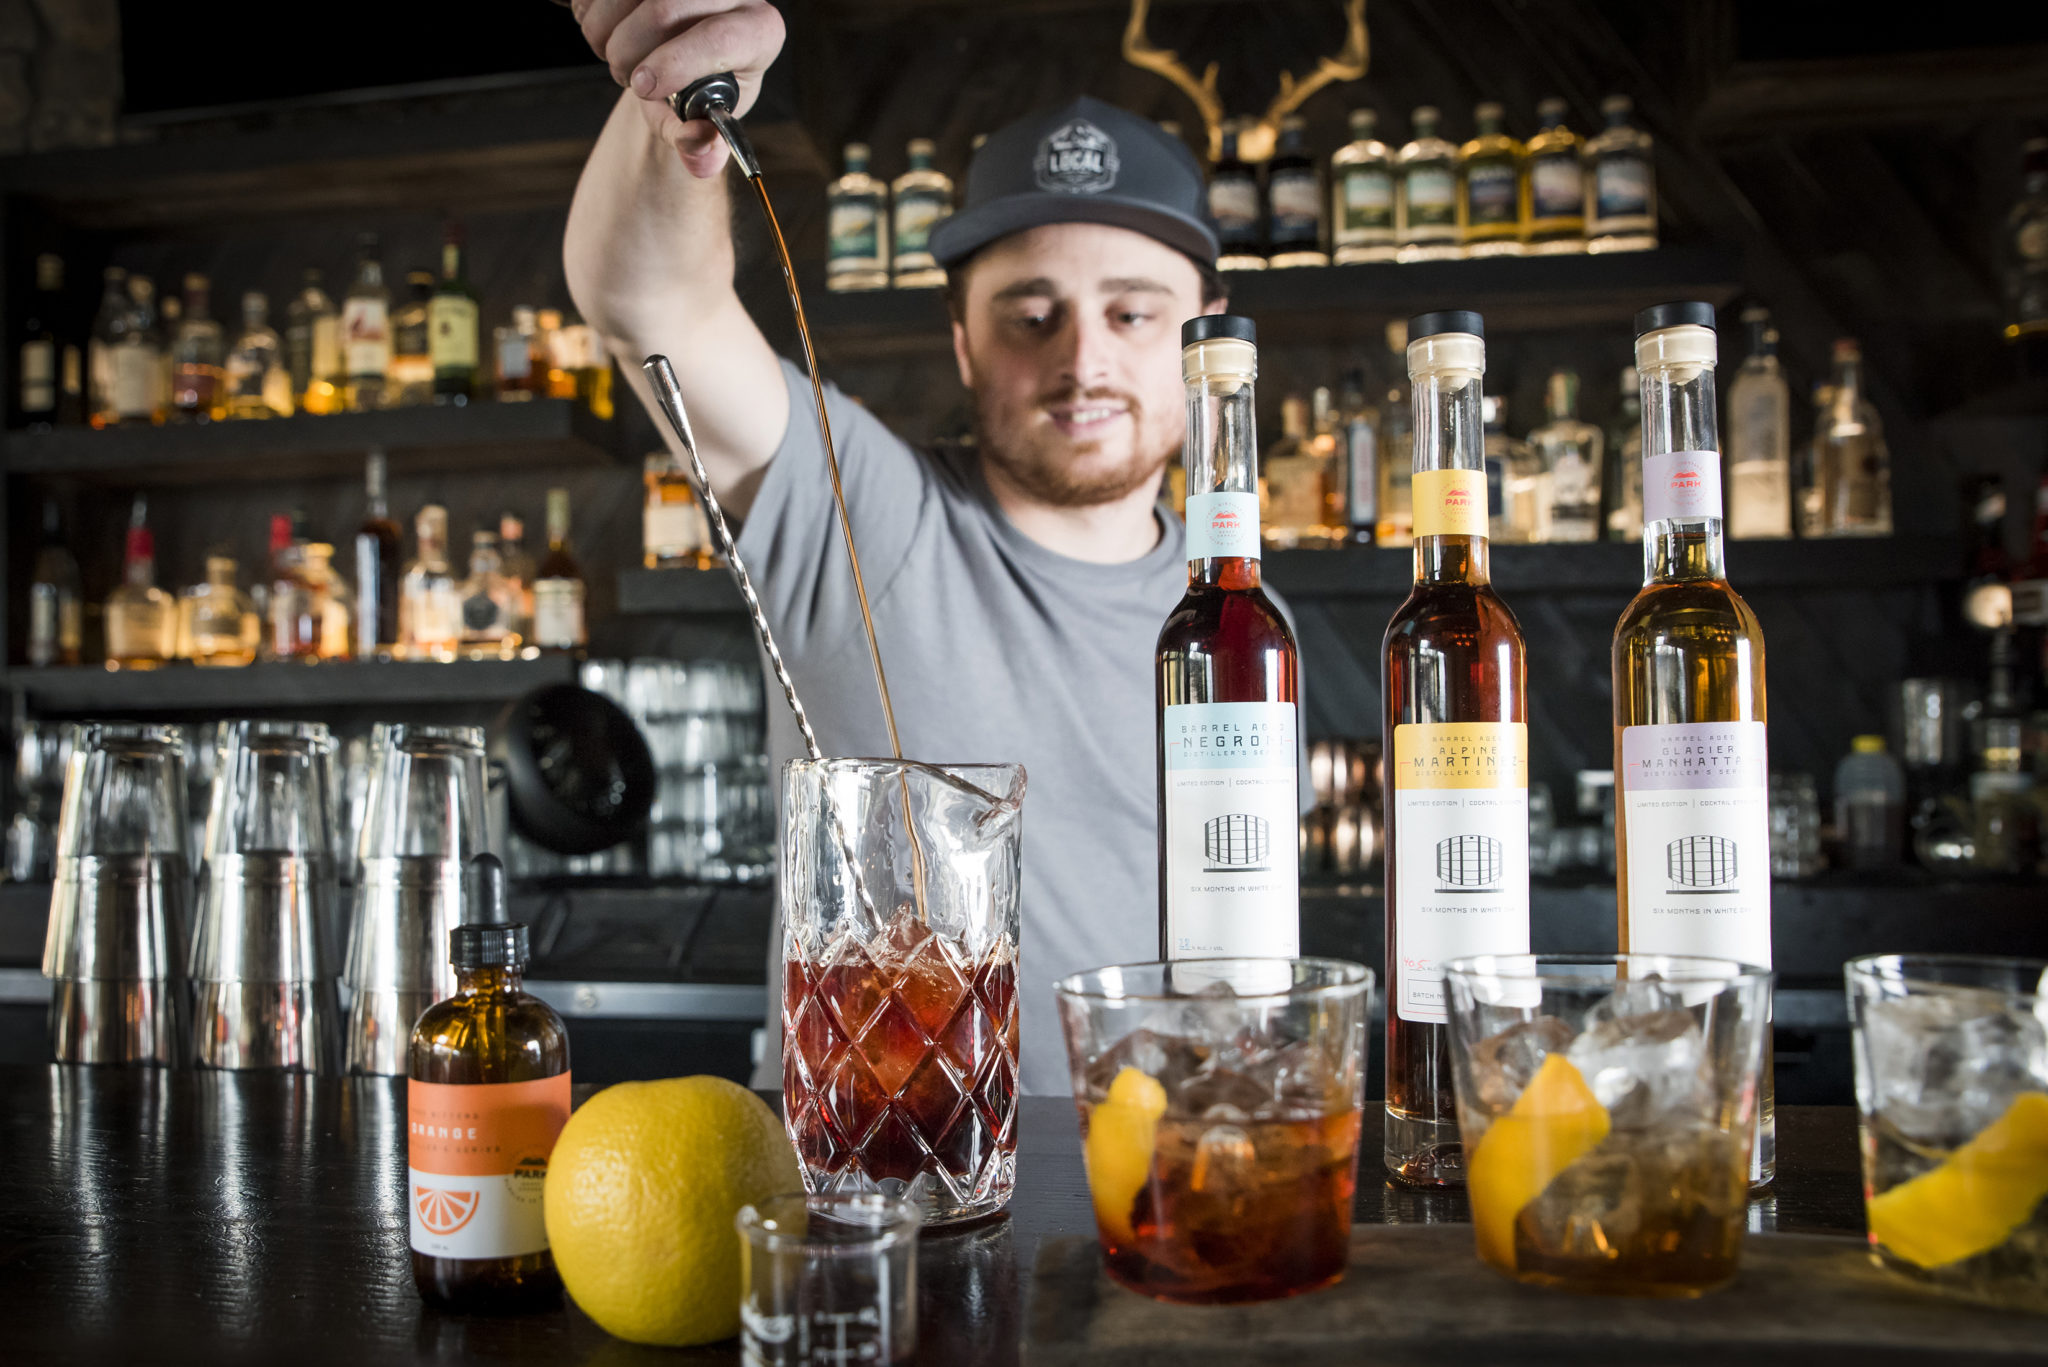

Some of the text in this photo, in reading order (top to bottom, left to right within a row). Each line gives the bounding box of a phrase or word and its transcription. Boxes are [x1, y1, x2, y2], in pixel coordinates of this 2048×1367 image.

[1050, 150, 1104, 173] LOCAL
[1671, 480, 1701, 488] PARK
[1212, 521, 1240, 529] PARK
[1181, 723, 1284, 733] BARREL AGD
[1440, 746, 1497, 755] ALPINE
[1662, 745, 1735, 755] GLACIER
[1414, 756, 1518, 768] MARTINZ
[1642, 756, 1743, 769] MANHATTA
[1204, 885, 1236, 893] MONTHS
[1436, 906, 1467, 914] MONTHS
[1667, 907, 1700, 915] MONTHS
[1412, 991, 1435, 999] BATCH
[412, 1122, 477, 1140] ORANGE
